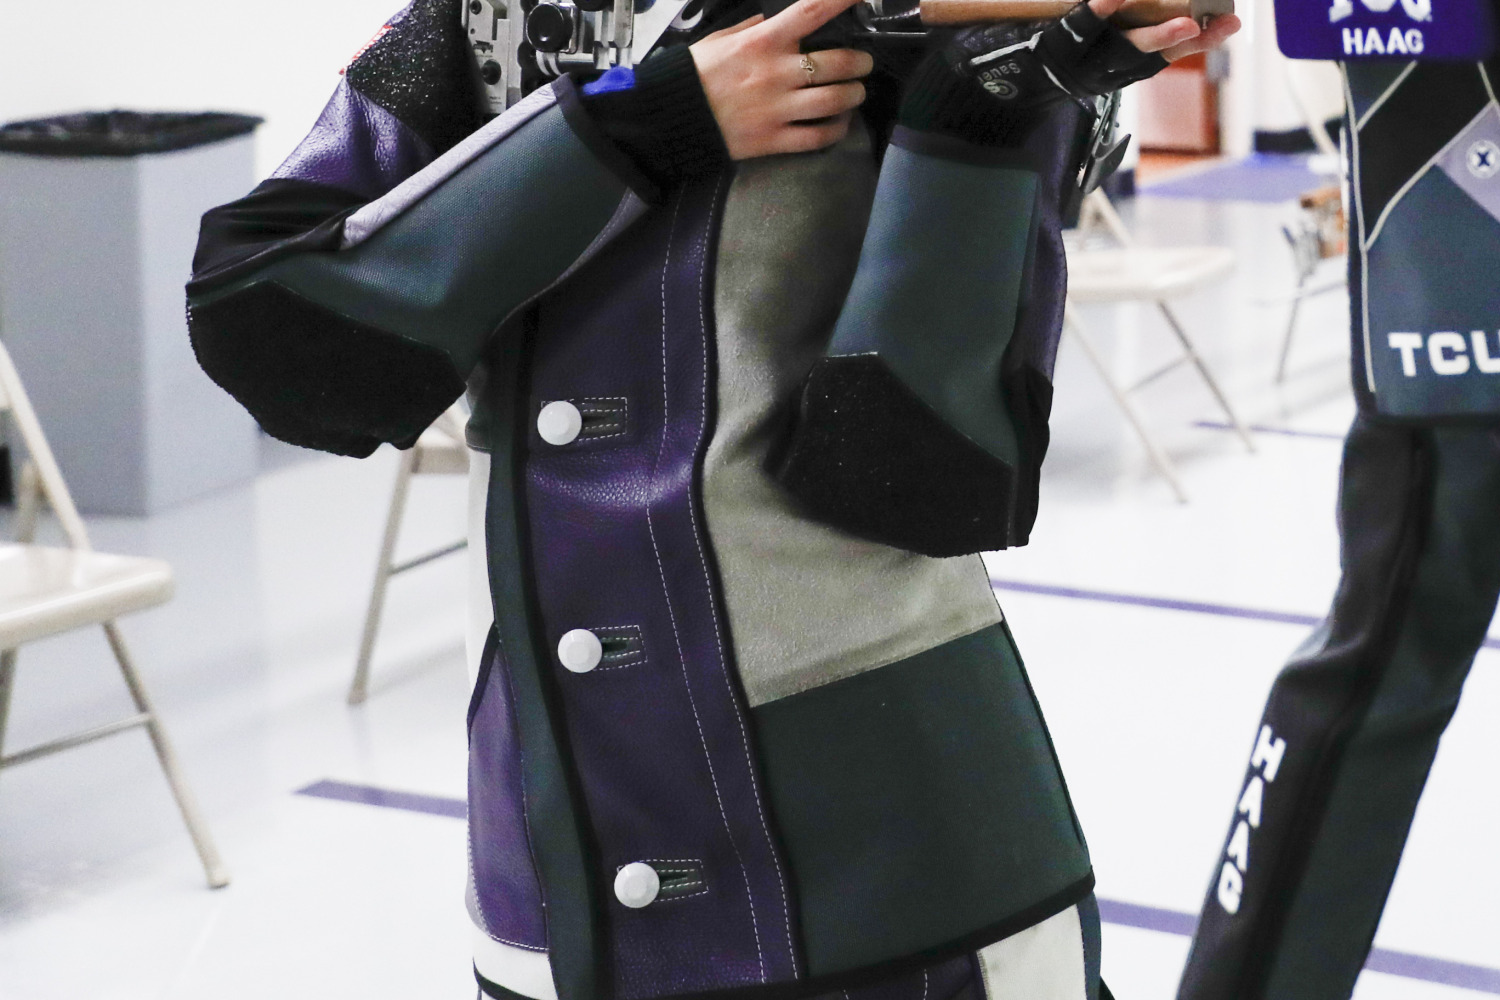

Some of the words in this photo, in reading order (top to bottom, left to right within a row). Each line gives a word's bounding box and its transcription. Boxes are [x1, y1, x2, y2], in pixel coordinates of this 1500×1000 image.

[1341, 27, 1424, 55] HAAG
[977, 62, 1021, 84] Sauer
[1218, 724, 1287, 914] HAAG
